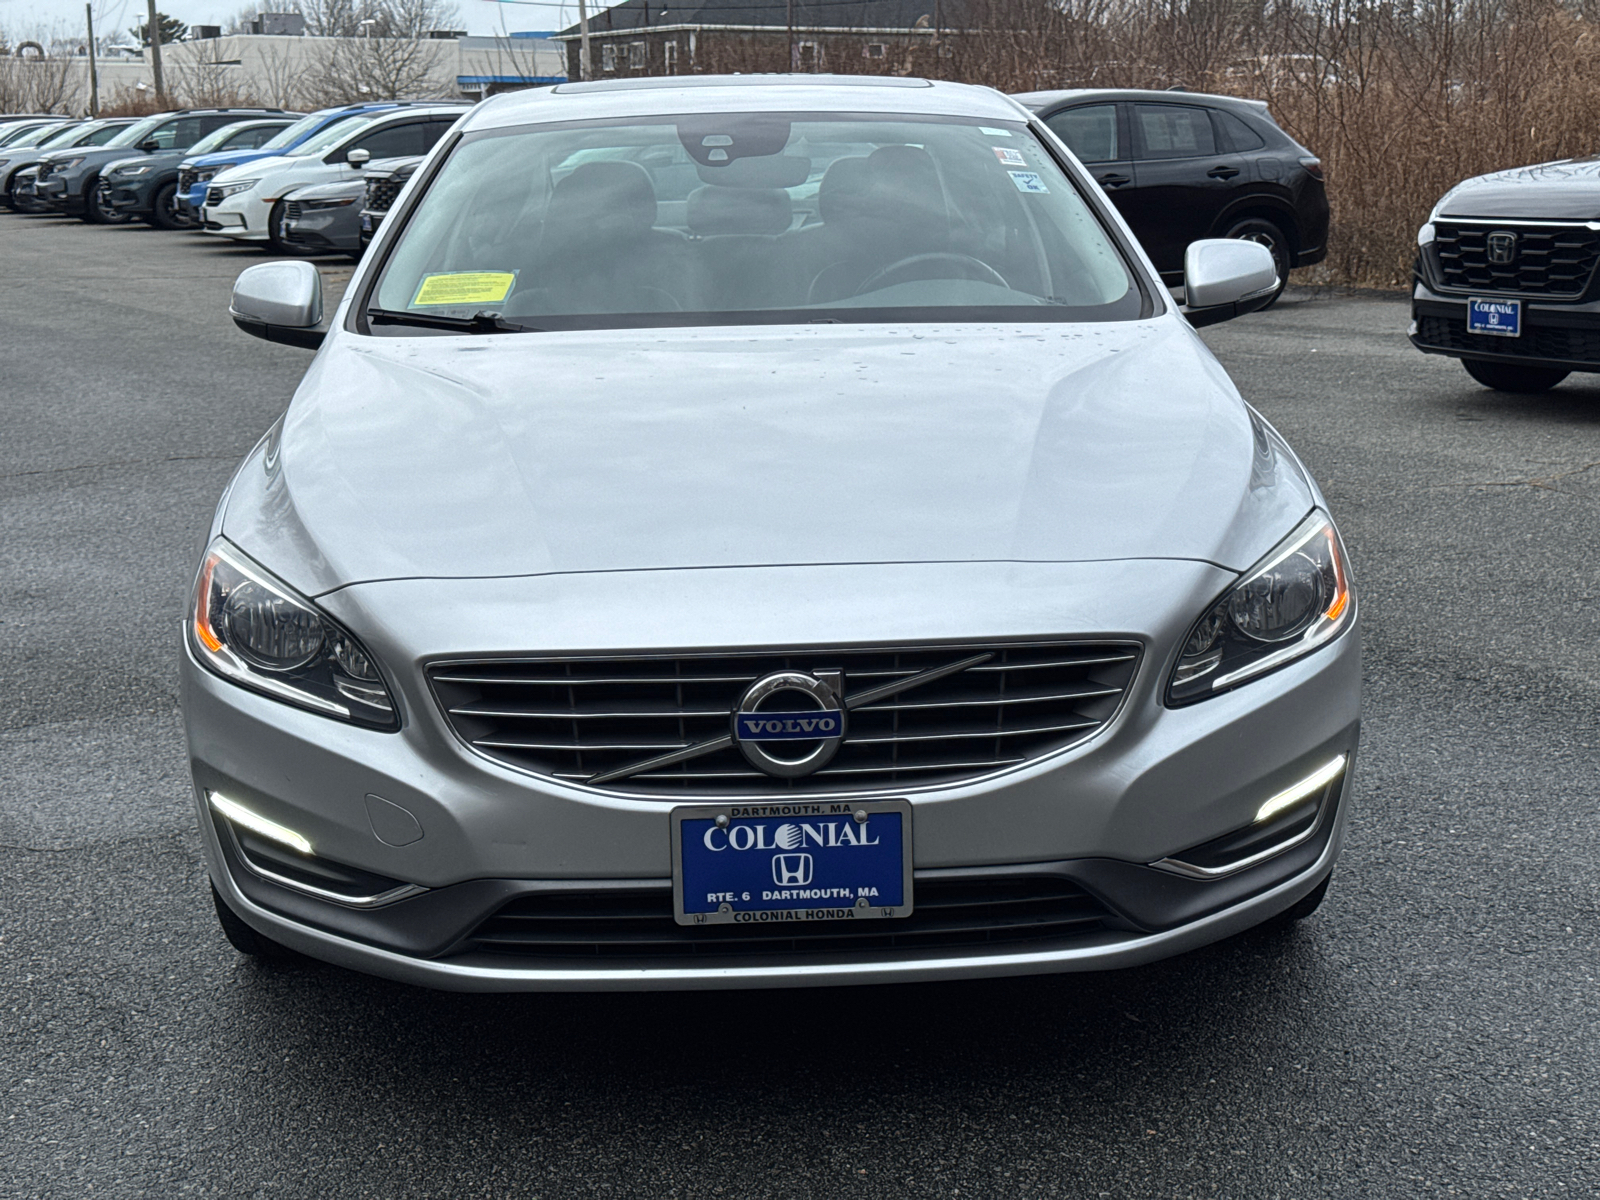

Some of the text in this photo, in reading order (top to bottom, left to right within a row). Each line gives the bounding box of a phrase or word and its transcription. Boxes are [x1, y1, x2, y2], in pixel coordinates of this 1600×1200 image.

[1474, 302, 1515, 315] COLONIAL
[743, 718, 836, 734] VOLVO
[731, 804, 852, 817] DARTMOUTH, MA
[703, 821, 880, 851] COLONIAL
[707, 887, 879, 903] RTE. 6 DARTMOUTH, MA
[733, 908, 855, 923] COLONIAL HONDA
